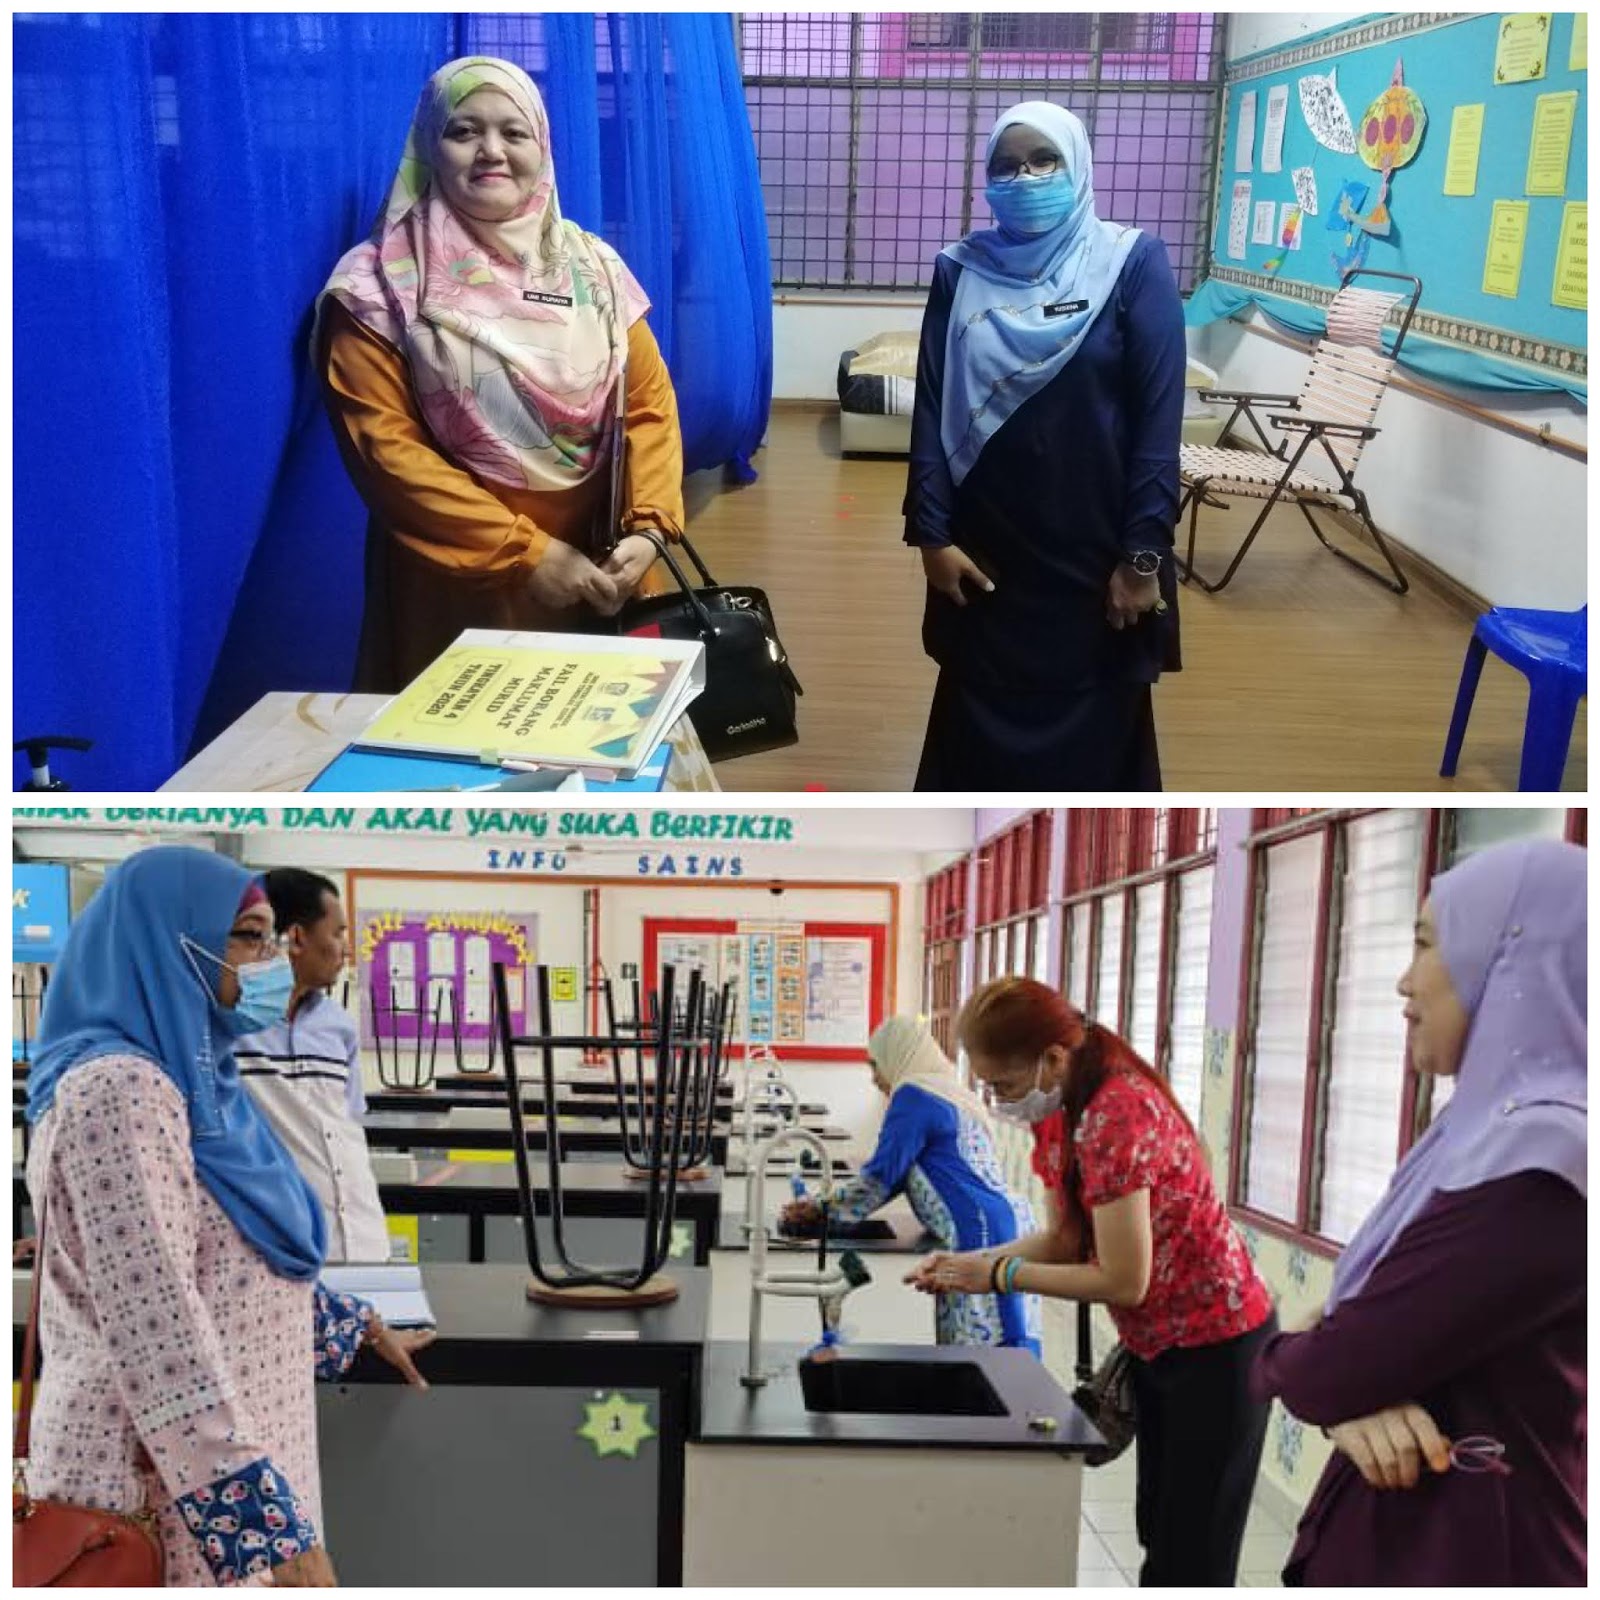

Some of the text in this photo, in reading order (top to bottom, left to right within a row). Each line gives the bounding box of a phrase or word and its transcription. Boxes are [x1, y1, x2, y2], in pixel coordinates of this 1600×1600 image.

[426, 664, 482, 715] TAHUN 2020
[451, 664, 503, 711] TINGKATAN
[552, 663, 578, 686] FAIL
[486, 677, 524, 713] MURID
[497, 666, 555, 729] MAKLUMAT
[515, 688, 560, 736] BORANG
[282, 808, 356, 828] DAN
[366, 808, 454, 831] AKAL
[558, 812, 640, 838] SUKA
[638, 855, 743, 876] SAINS
[613, 1414, 622, 1431] 1
